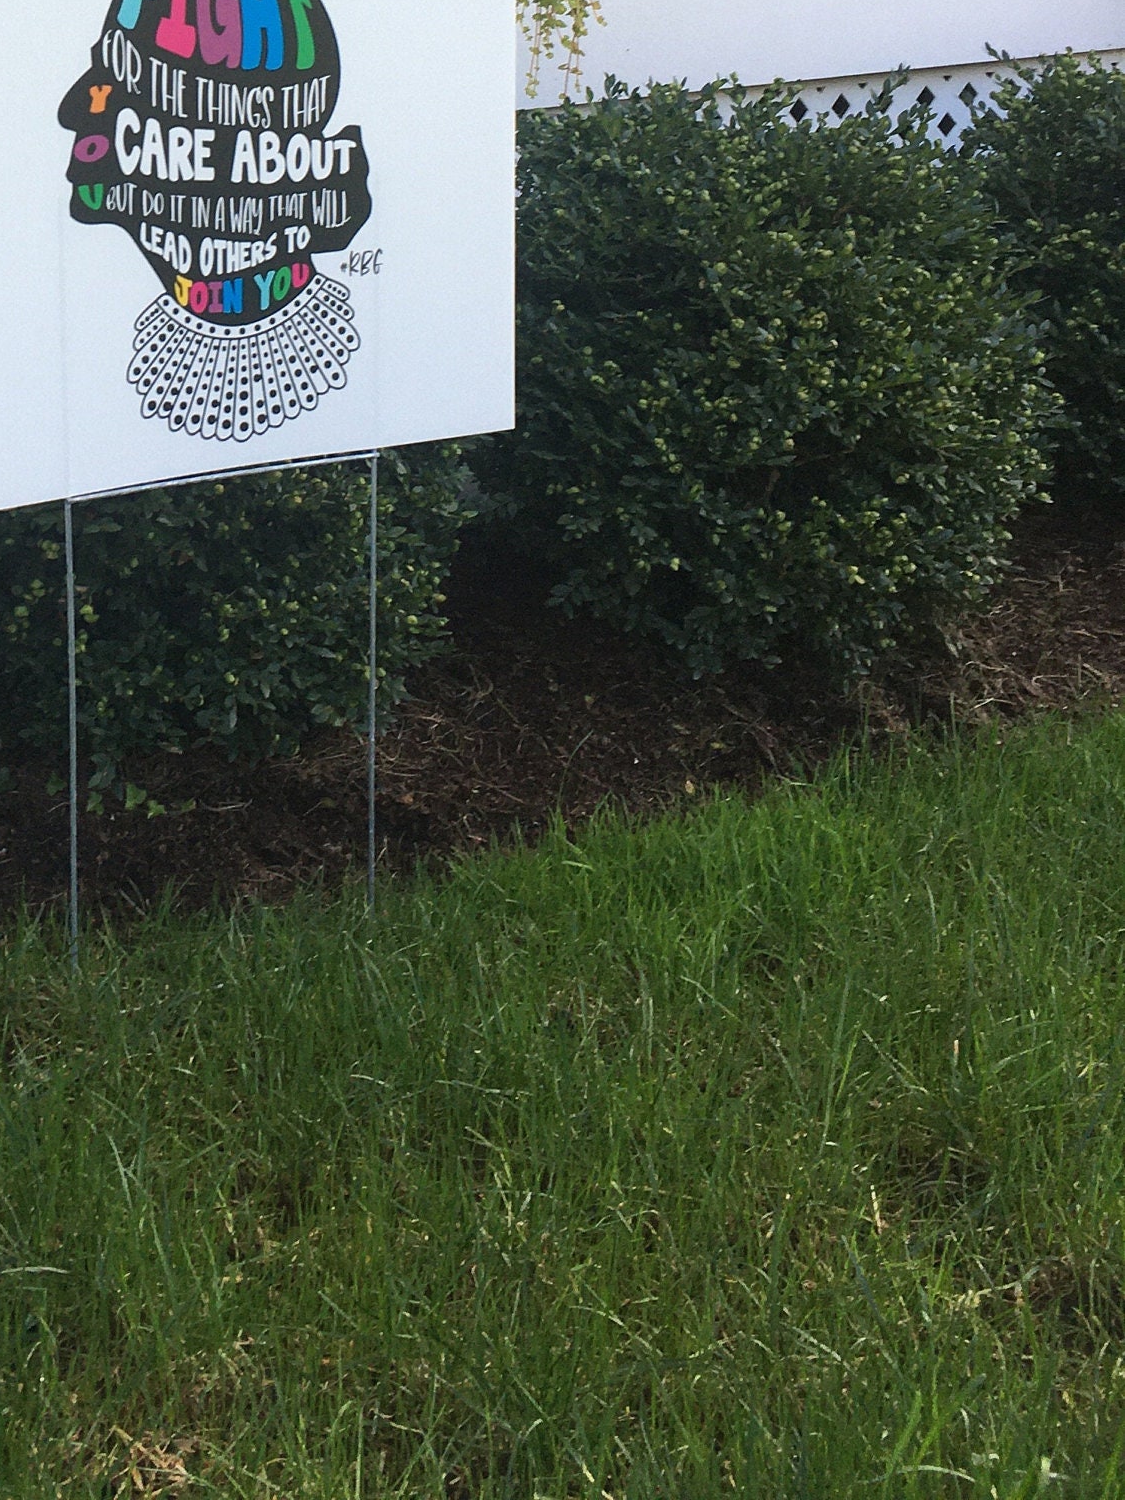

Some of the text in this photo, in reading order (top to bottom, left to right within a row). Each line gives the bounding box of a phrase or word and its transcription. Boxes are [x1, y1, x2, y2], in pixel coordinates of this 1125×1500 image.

[101, 29, 332, 129] FOR THE THINGS THAT
[115, 107, 357, 184] CARE ABOUT
[105, 182, 352, 236] BUT DO IT IN A WAY THAT WILL
[139, 222, 312, 277] LEAD OTHERS TO
[174, 263, 310, 314] JOIN YOU
